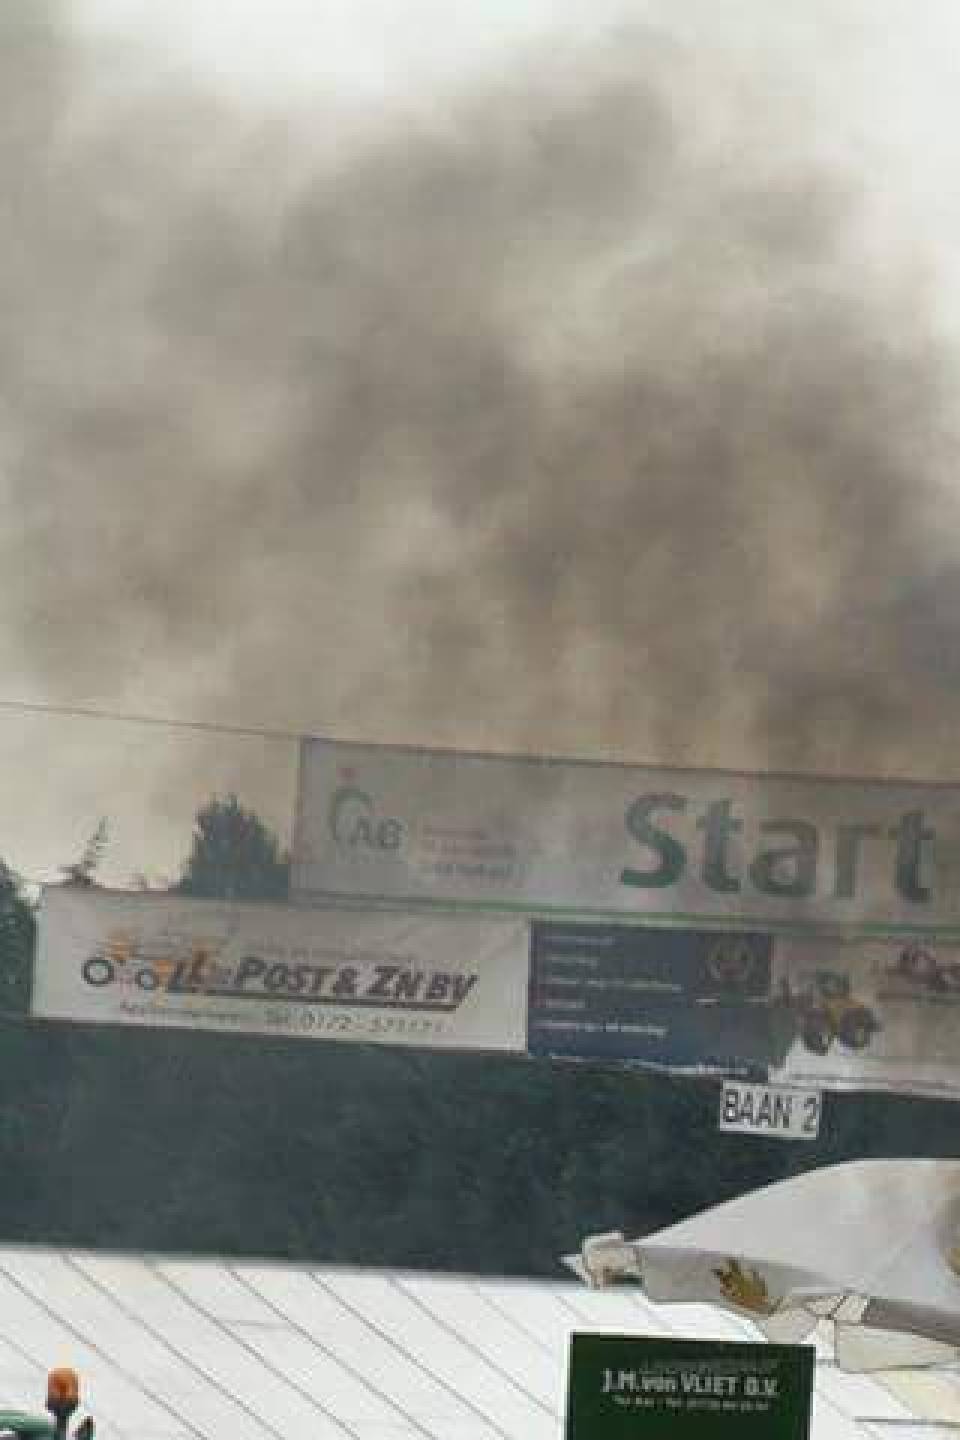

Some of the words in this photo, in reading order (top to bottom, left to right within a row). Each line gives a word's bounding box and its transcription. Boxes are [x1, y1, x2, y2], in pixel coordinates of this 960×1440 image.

[618, 791, 938, 903] Start
[234, 956, 334, 993] POST
[332, 966, 359, 995] &
[724, 1089, 793, 1129] BAAN
[801, 1096, 819, 1133] 2
[680, 1371, 737, 1395] VLIET
